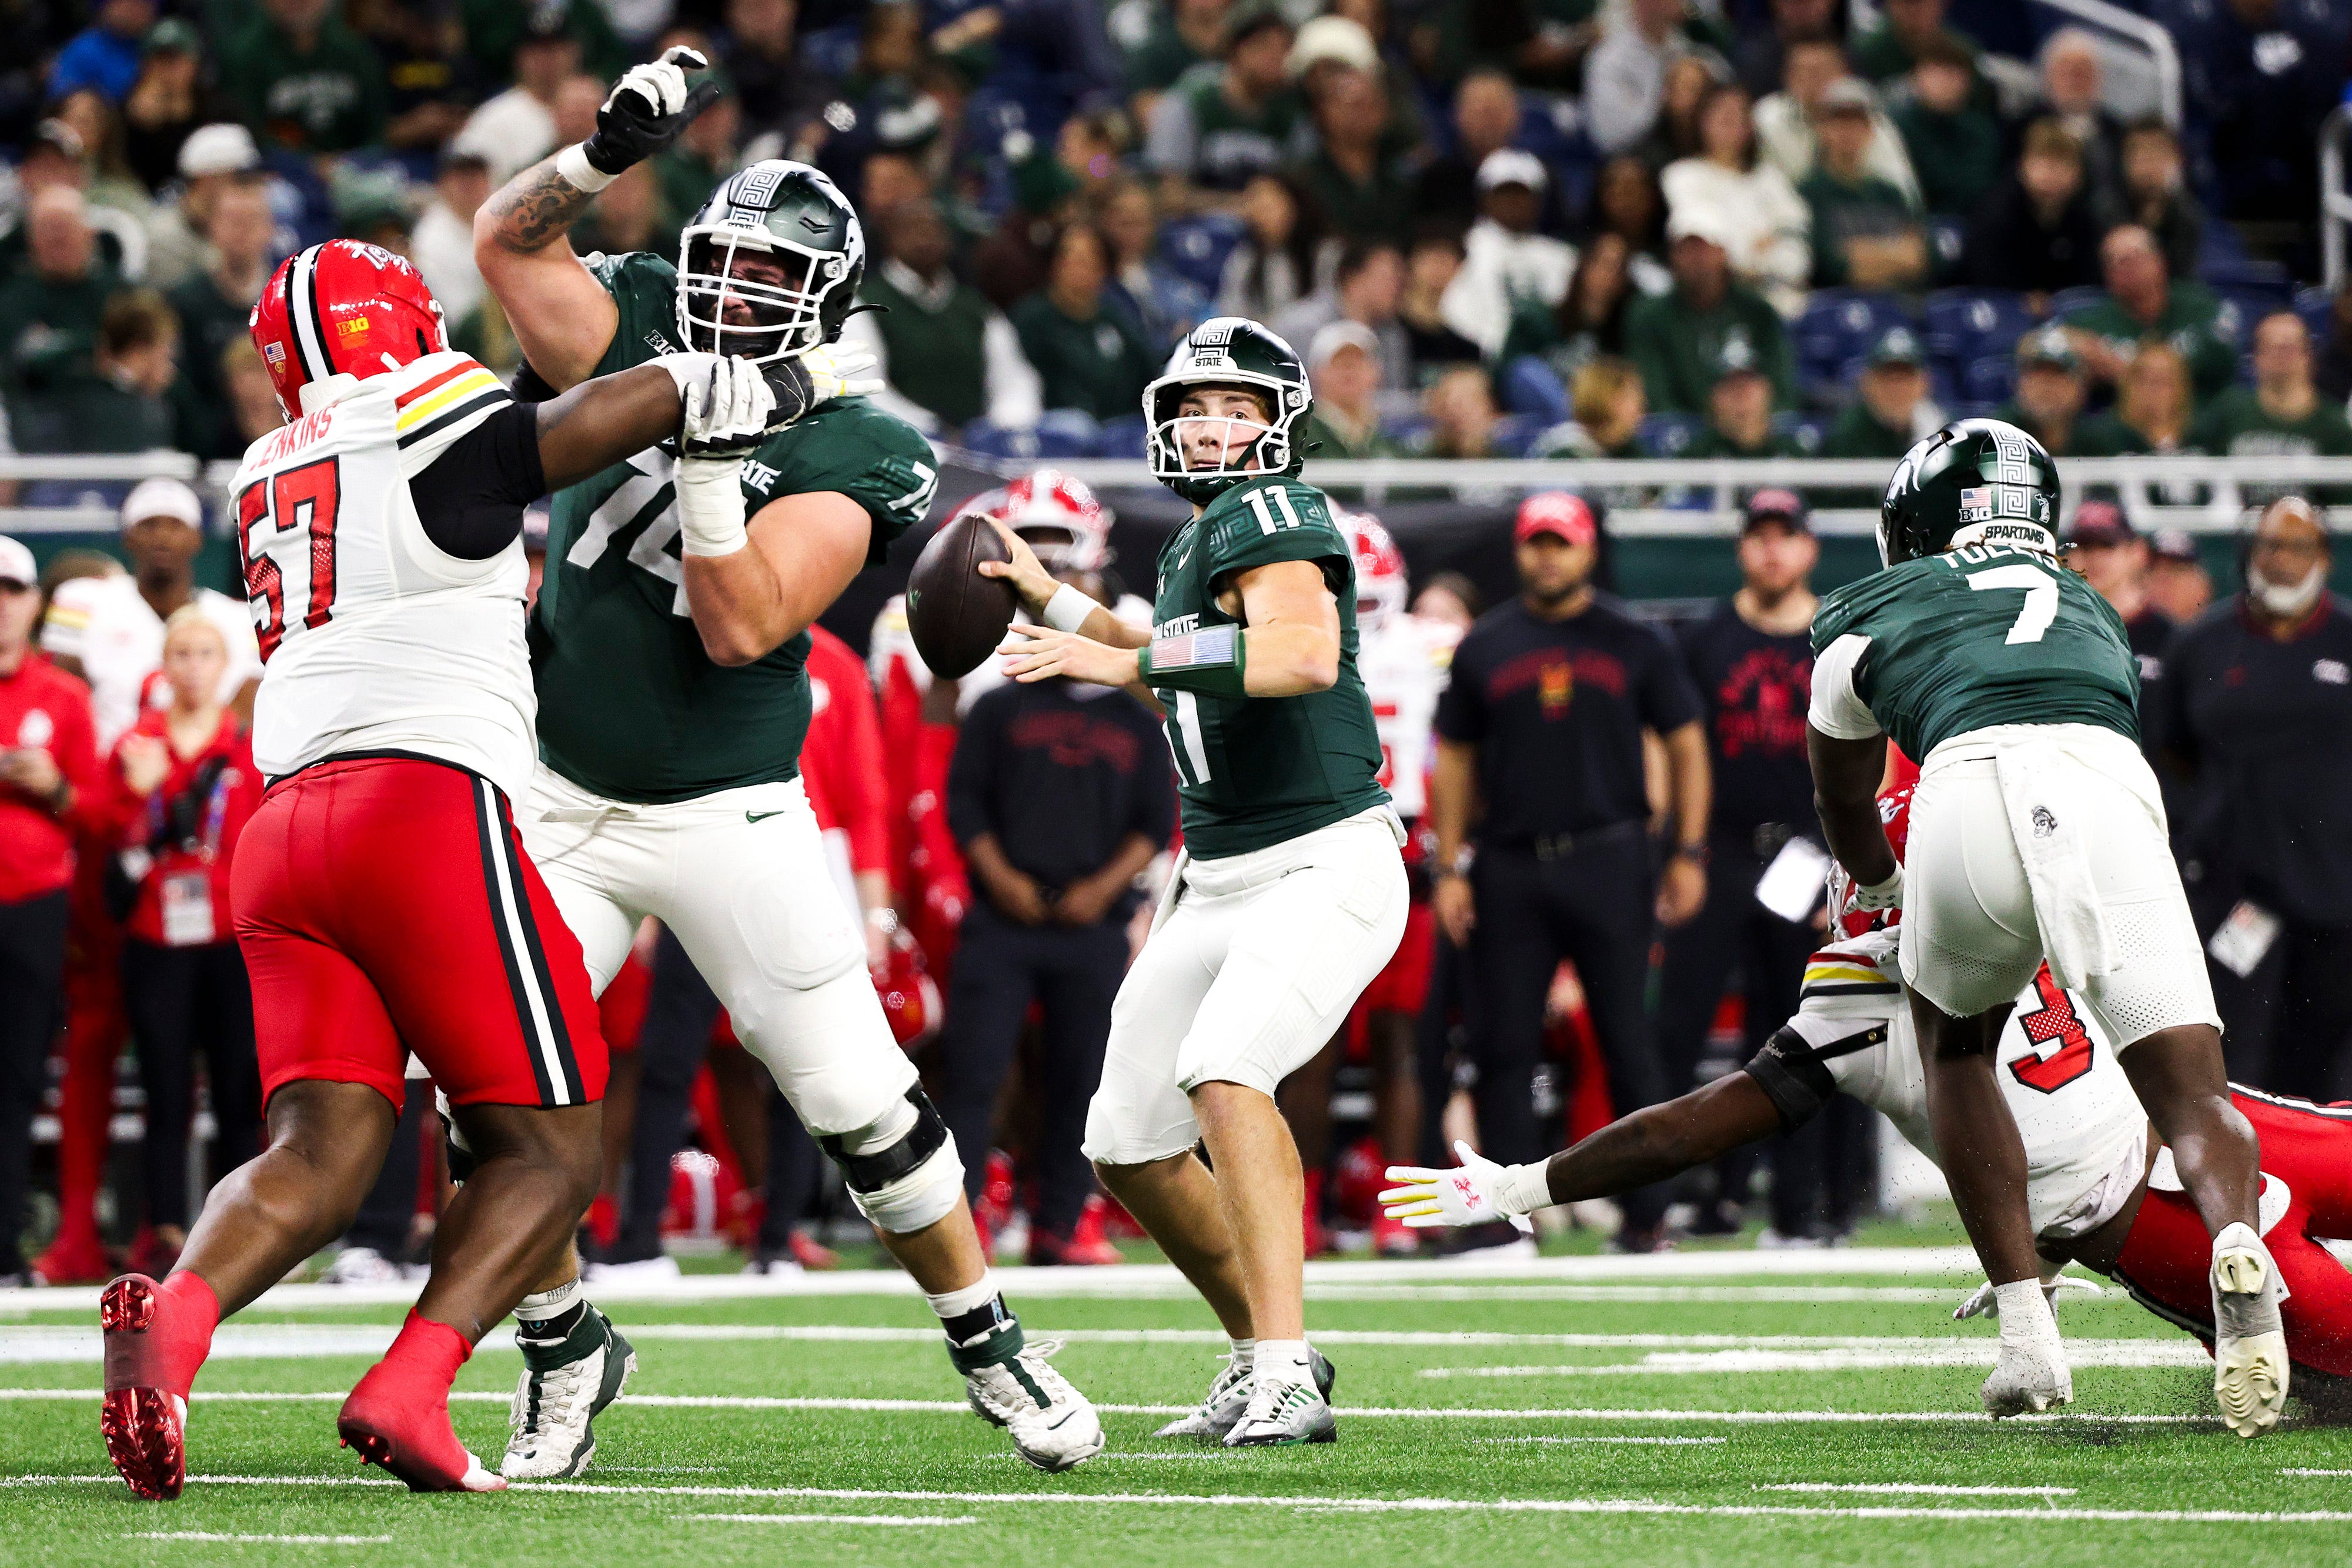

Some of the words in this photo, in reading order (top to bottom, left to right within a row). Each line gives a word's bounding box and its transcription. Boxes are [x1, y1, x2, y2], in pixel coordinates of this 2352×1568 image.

[1195, 357, 1222, 367] STATE
[248, 404, 336, 472] ENKINS
[740, 459, 783, 496] ATE
[886, 460, 939, 522] 74
[1241, 484, 1301, 537] 11
[1985, 525, 2045, 545] SPARTANS
[238, 454, 341, 667] 57
[1965, 563, 2059, 645] 7
[1152, 687, 1212, 788] 11
